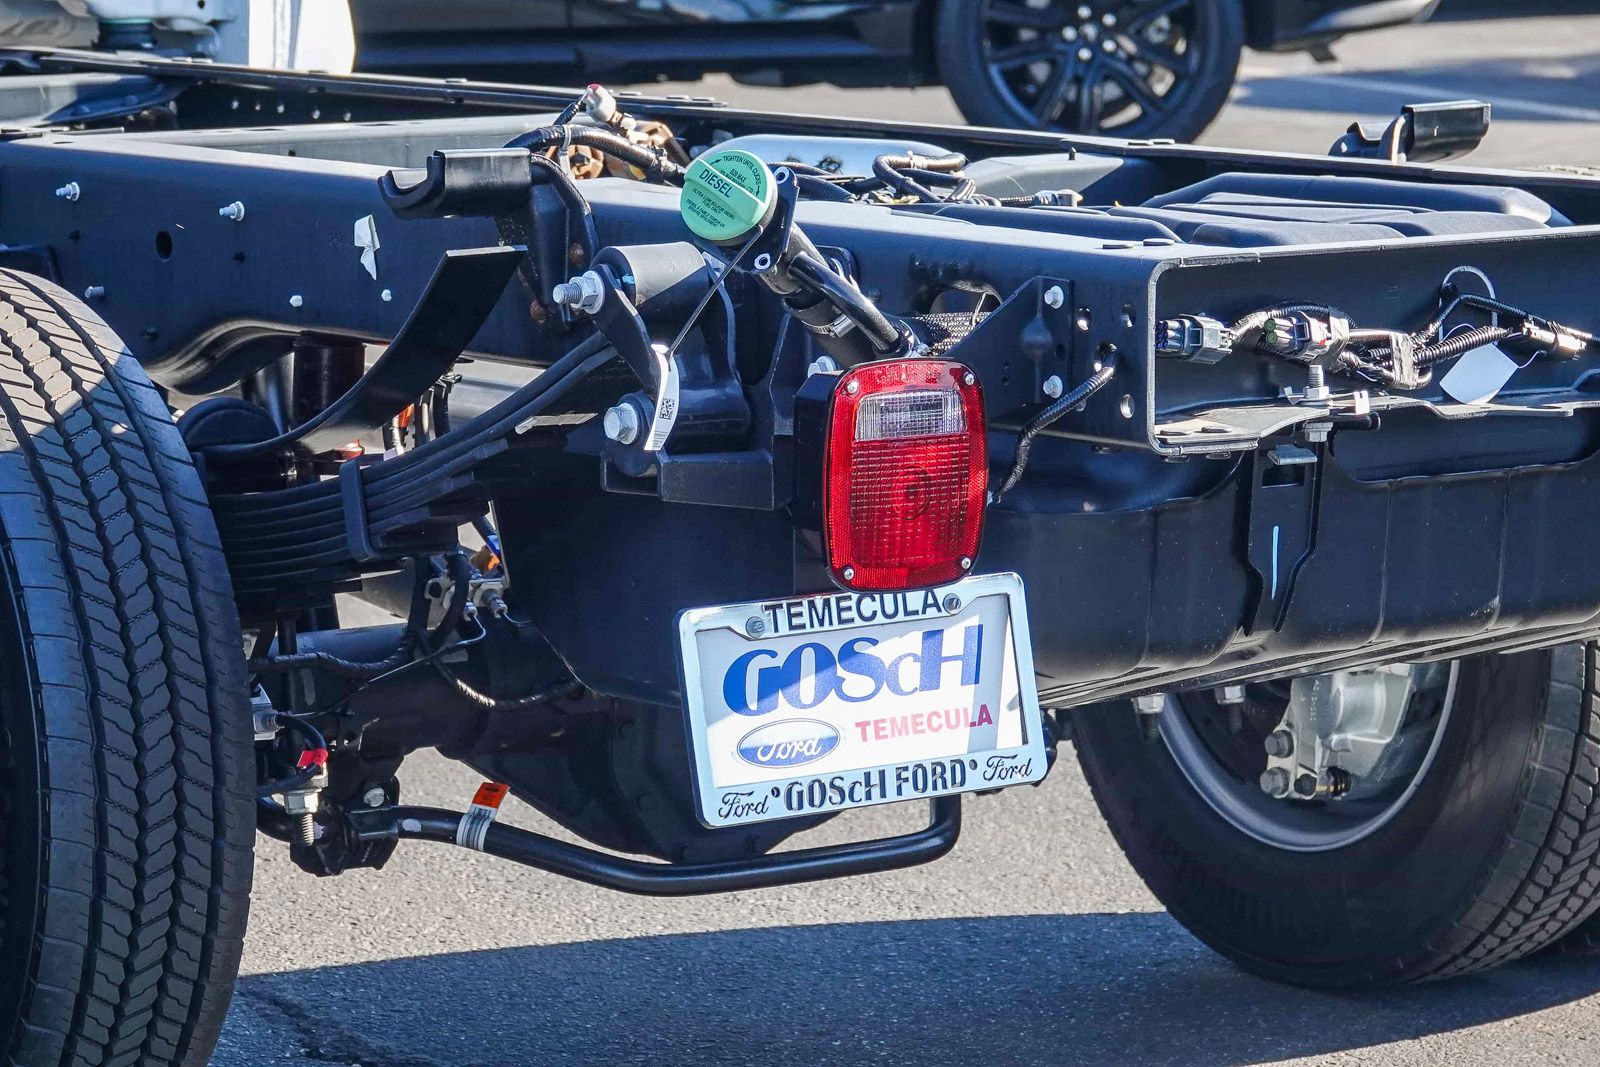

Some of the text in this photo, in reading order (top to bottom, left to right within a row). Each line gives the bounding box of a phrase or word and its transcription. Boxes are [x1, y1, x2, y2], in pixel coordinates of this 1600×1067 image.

[699, 169, 733, 198] DIESEL
[763, 589, 943, 634] TEMECULA
[855, 704, 993, 742] TEMECULA
[757, 736, 822, 761] Ford
[718, 791, 769, 819] Ford
[896, 758, 966, 797] FORD
[982, 754, 1033, 782] Ford
